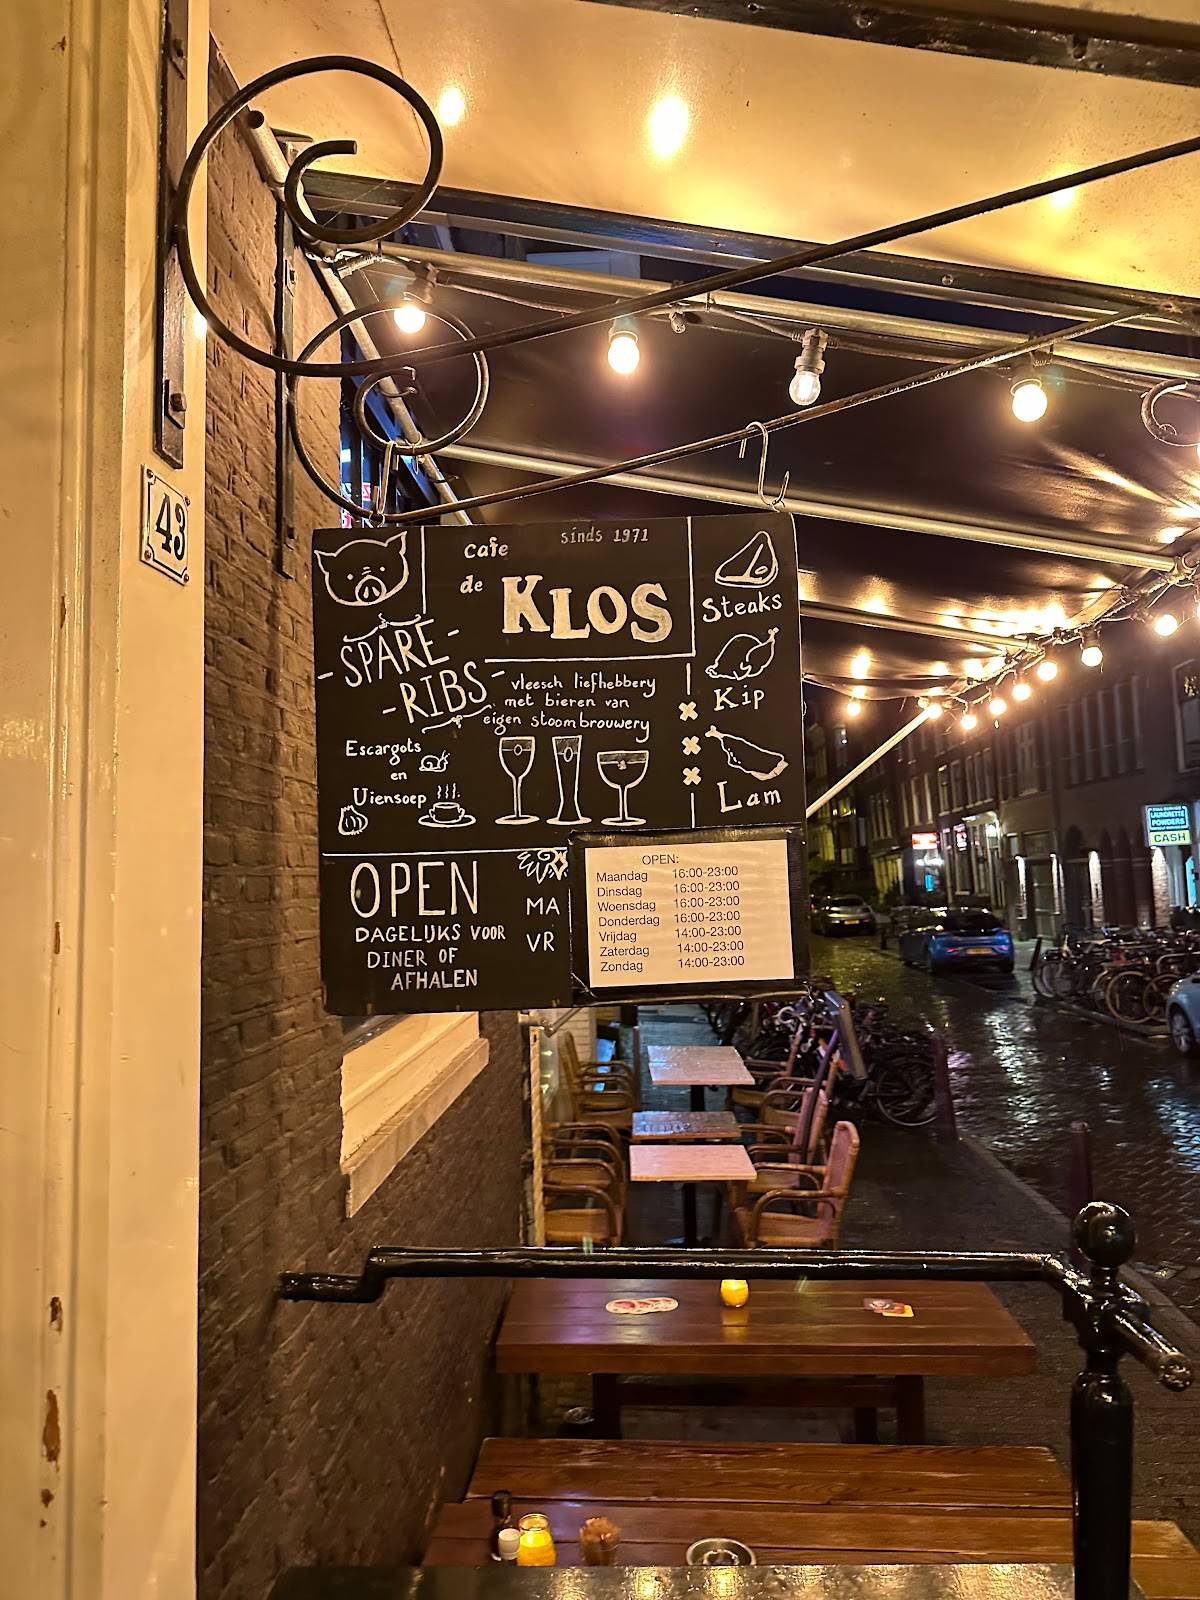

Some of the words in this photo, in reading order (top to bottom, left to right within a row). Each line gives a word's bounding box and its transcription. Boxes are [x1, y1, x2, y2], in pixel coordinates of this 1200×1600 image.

[155, 492, 186, 561] 43
[560, 527, 603, 544] sinds
[613, 528, 649, 543] 1971
[460, 575, 482, 593] de
[502, 575, 672, 642] KLOS
[703, 591, 782, 622] Steaks
[340, 619, 450, 687] SPARE
[400, 661, 487, 723] RIBS
[511, 673, 563, 690] vleesch
[575, 672, 655, 700] liefhebbery
[505, 693, 534, 707] met
[545, 690, 595, 707] bieren
[605, 698, 630, 709] van
[714, 685, 764, 711] Kip
[481, 710, 521, 735] eigen
[346, 738, 422, 766] Escargots
[390, 771, 408, 781] en
[353, 788, 427, 809] Uiensoep
[717, 779, 781, 812] Lam
[1151, 818, 1185, 826] POWDERS
[1154, 833, 1186, 842] CASH
[641, 854, 679, 865] OPEN:
[596, 871, 648, 883] Maandag
[672, 866, 739, 879] 16:00-23:00
[351, 861, 477, 918] OPEN
[597, 886, 643, 898] Dinsdag
[673, 881, 740, 894] 16:00-23:00
[527, 897, 560, 915] MA
[598, 900, 656, 913] Woensdag
[674, 896, 740, 908] 16:00-23:00
[598, 915, 660, 927] Donderdag
[674, 911, 741, 923] 16:00-23:00
[356, 924, 460, 943] DAGELIJKS
[471, 925, 505, 940] VOOR
[527, 932, 554, 952] VR
[599, 930, 637, 944] Vrijdag
[675, 925, 742, 938] 14:00-23:00
[368, 950, 427, 968] DINER
[439, 947, 458, 963] OF
[600, 945, 650, 957] Zaterdag
[677, 940, 744, 953] 14:00-23:00
[600, 960, 643, 973] Zondag
[678, 955, 745, 968] 14:00-23:00
[391, 969, 477, 990] AFHALEN
